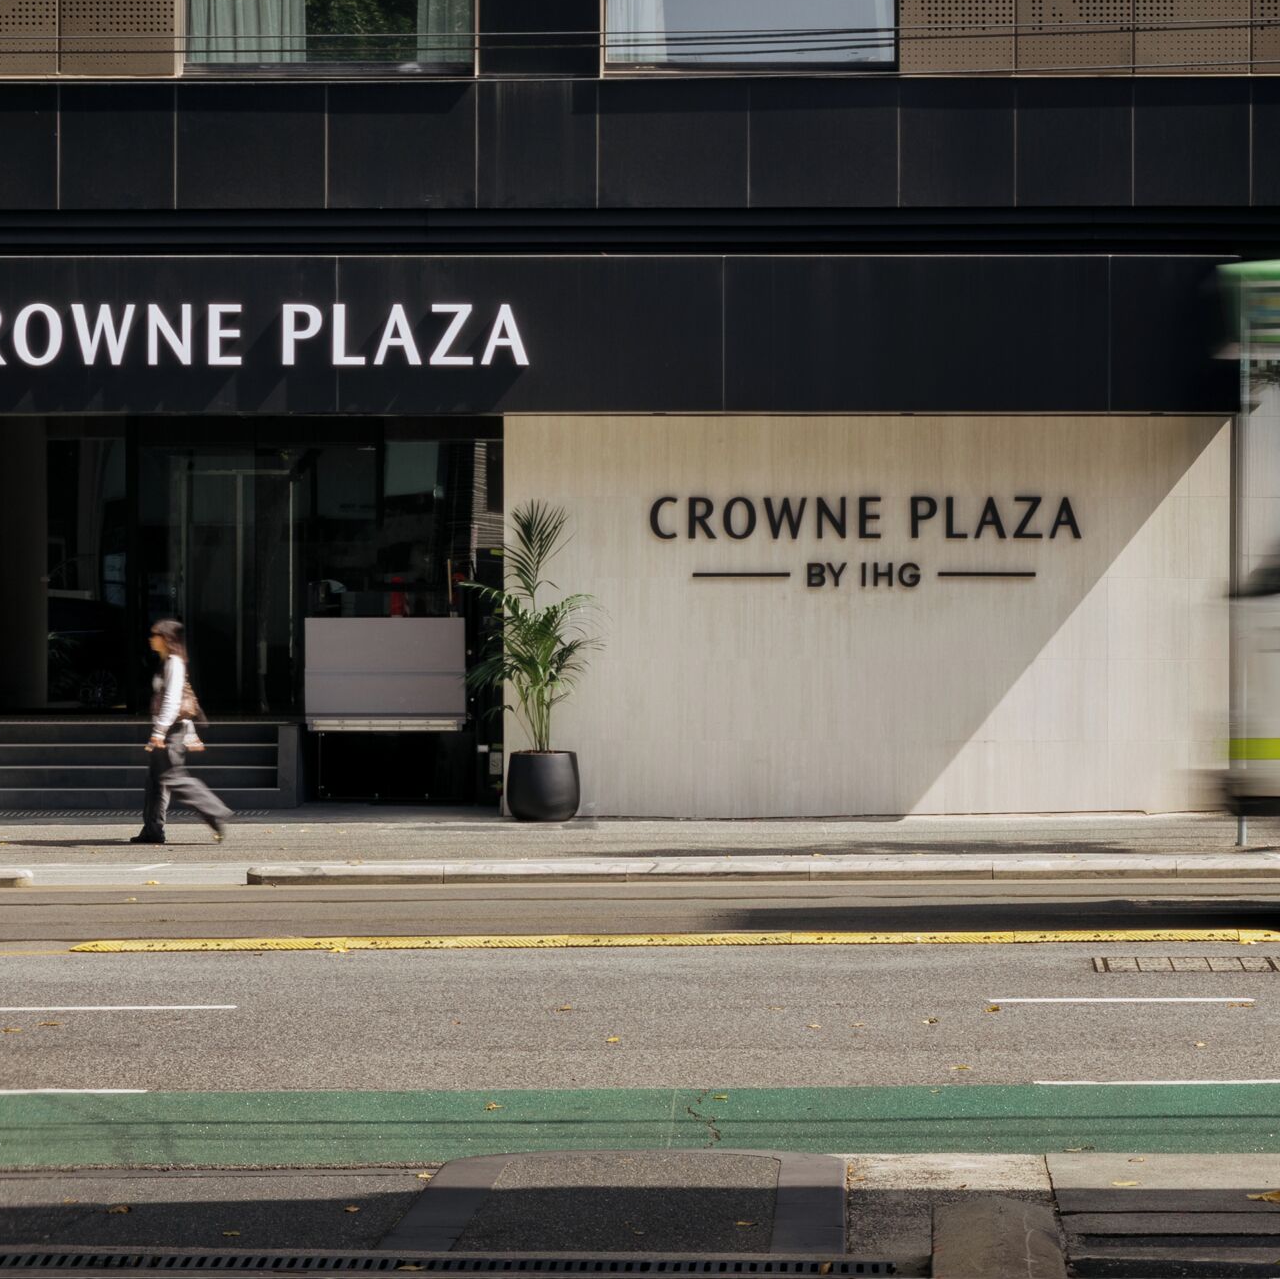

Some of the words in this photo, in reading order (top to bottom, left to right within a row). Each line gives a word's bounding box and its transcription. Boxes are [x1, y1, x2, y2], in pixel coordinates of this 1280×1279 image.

[282, 303, 531, 366] PLAZA
[648, 496, 882, 540] CROWNE
[910, 496, 1083, 540] PLAZA
[806, 562, 848, 588] BY
[860, 562, 922, 588] IHG
